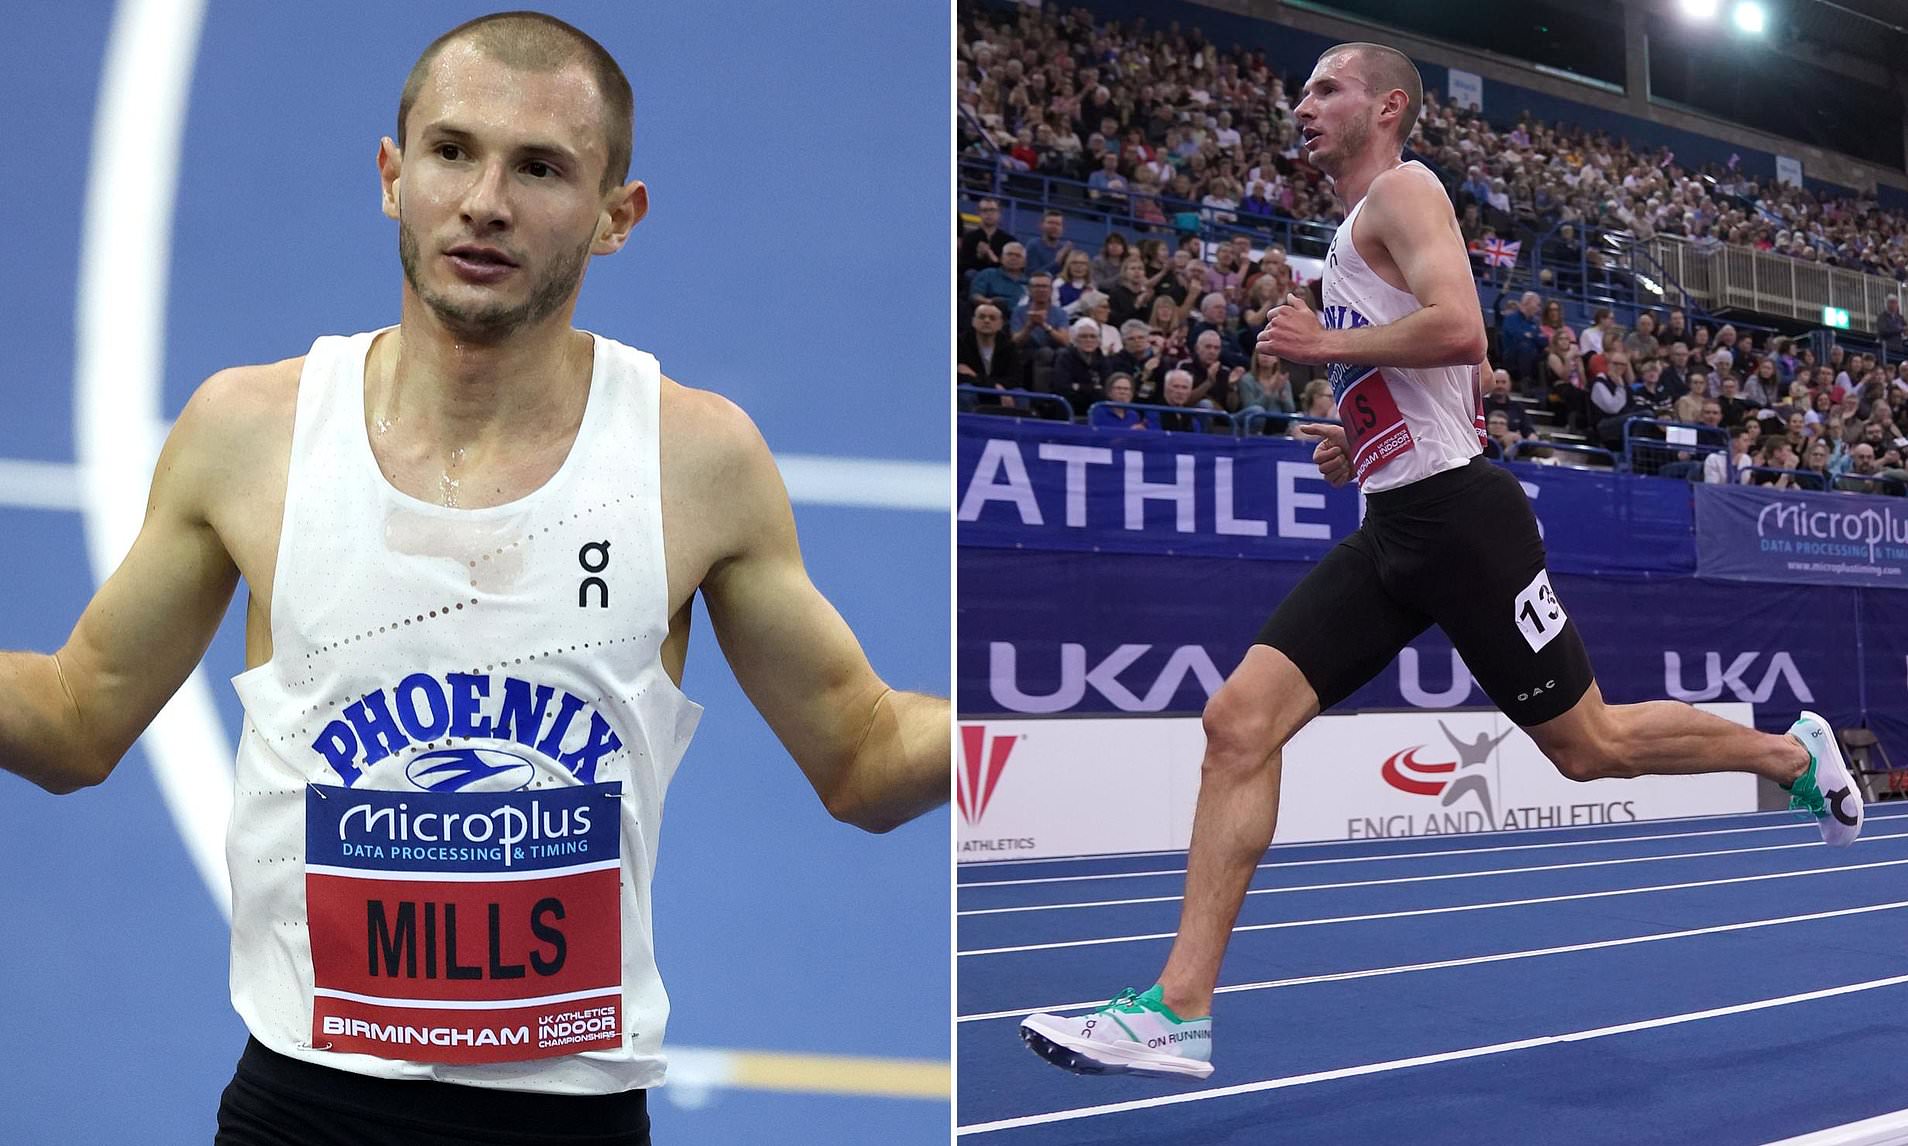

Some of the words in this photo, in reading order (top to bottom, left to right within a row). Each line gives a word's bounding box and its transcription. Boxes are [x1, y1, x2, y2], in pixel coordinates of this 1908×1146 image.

[958, 440, 1545, 541] ATHLE
[1757, 502, 1908, 563] Microplu
[1760, 538, 1792, 553] DATA
[1796, 541, 1868, 558] PROCESSING
[1520, 584, 1559, 634] 13
[990, 641, 1225, 713] UKA
[1664, 651, 1814, 703] UKA
[312, 673, 623, 787] PHOENIX
[339, 800, 592, 866] Microplus
[1347, 810, 1485, 840] ENGLAND
[1503, 801, 1636, 831] ATHLETICS
[343, 843, 384, 859] DATA
[391, 846, 501, 861] PROCESSING
[513, 849, 525, 860] &
[530, 839, 588, 858] TIMING
[962, 838, 1035, 852] ATHLETICS
[366, 897, 568, 980] MILLS
[323, 1016, 530, 1047] BIRMINGHAM
[538, 1014, 556, 1025] UK
[557, 1006, 616, 1023] ATHLETICS
[538, 1016, 616, 1040] INDOOR
[538, 1030, 617, 1048] CHAMPIONSHIPS
[1148, 1035, 1167, 1049] ON
[1168, 1029, 1212, 1044] RUNNIN
